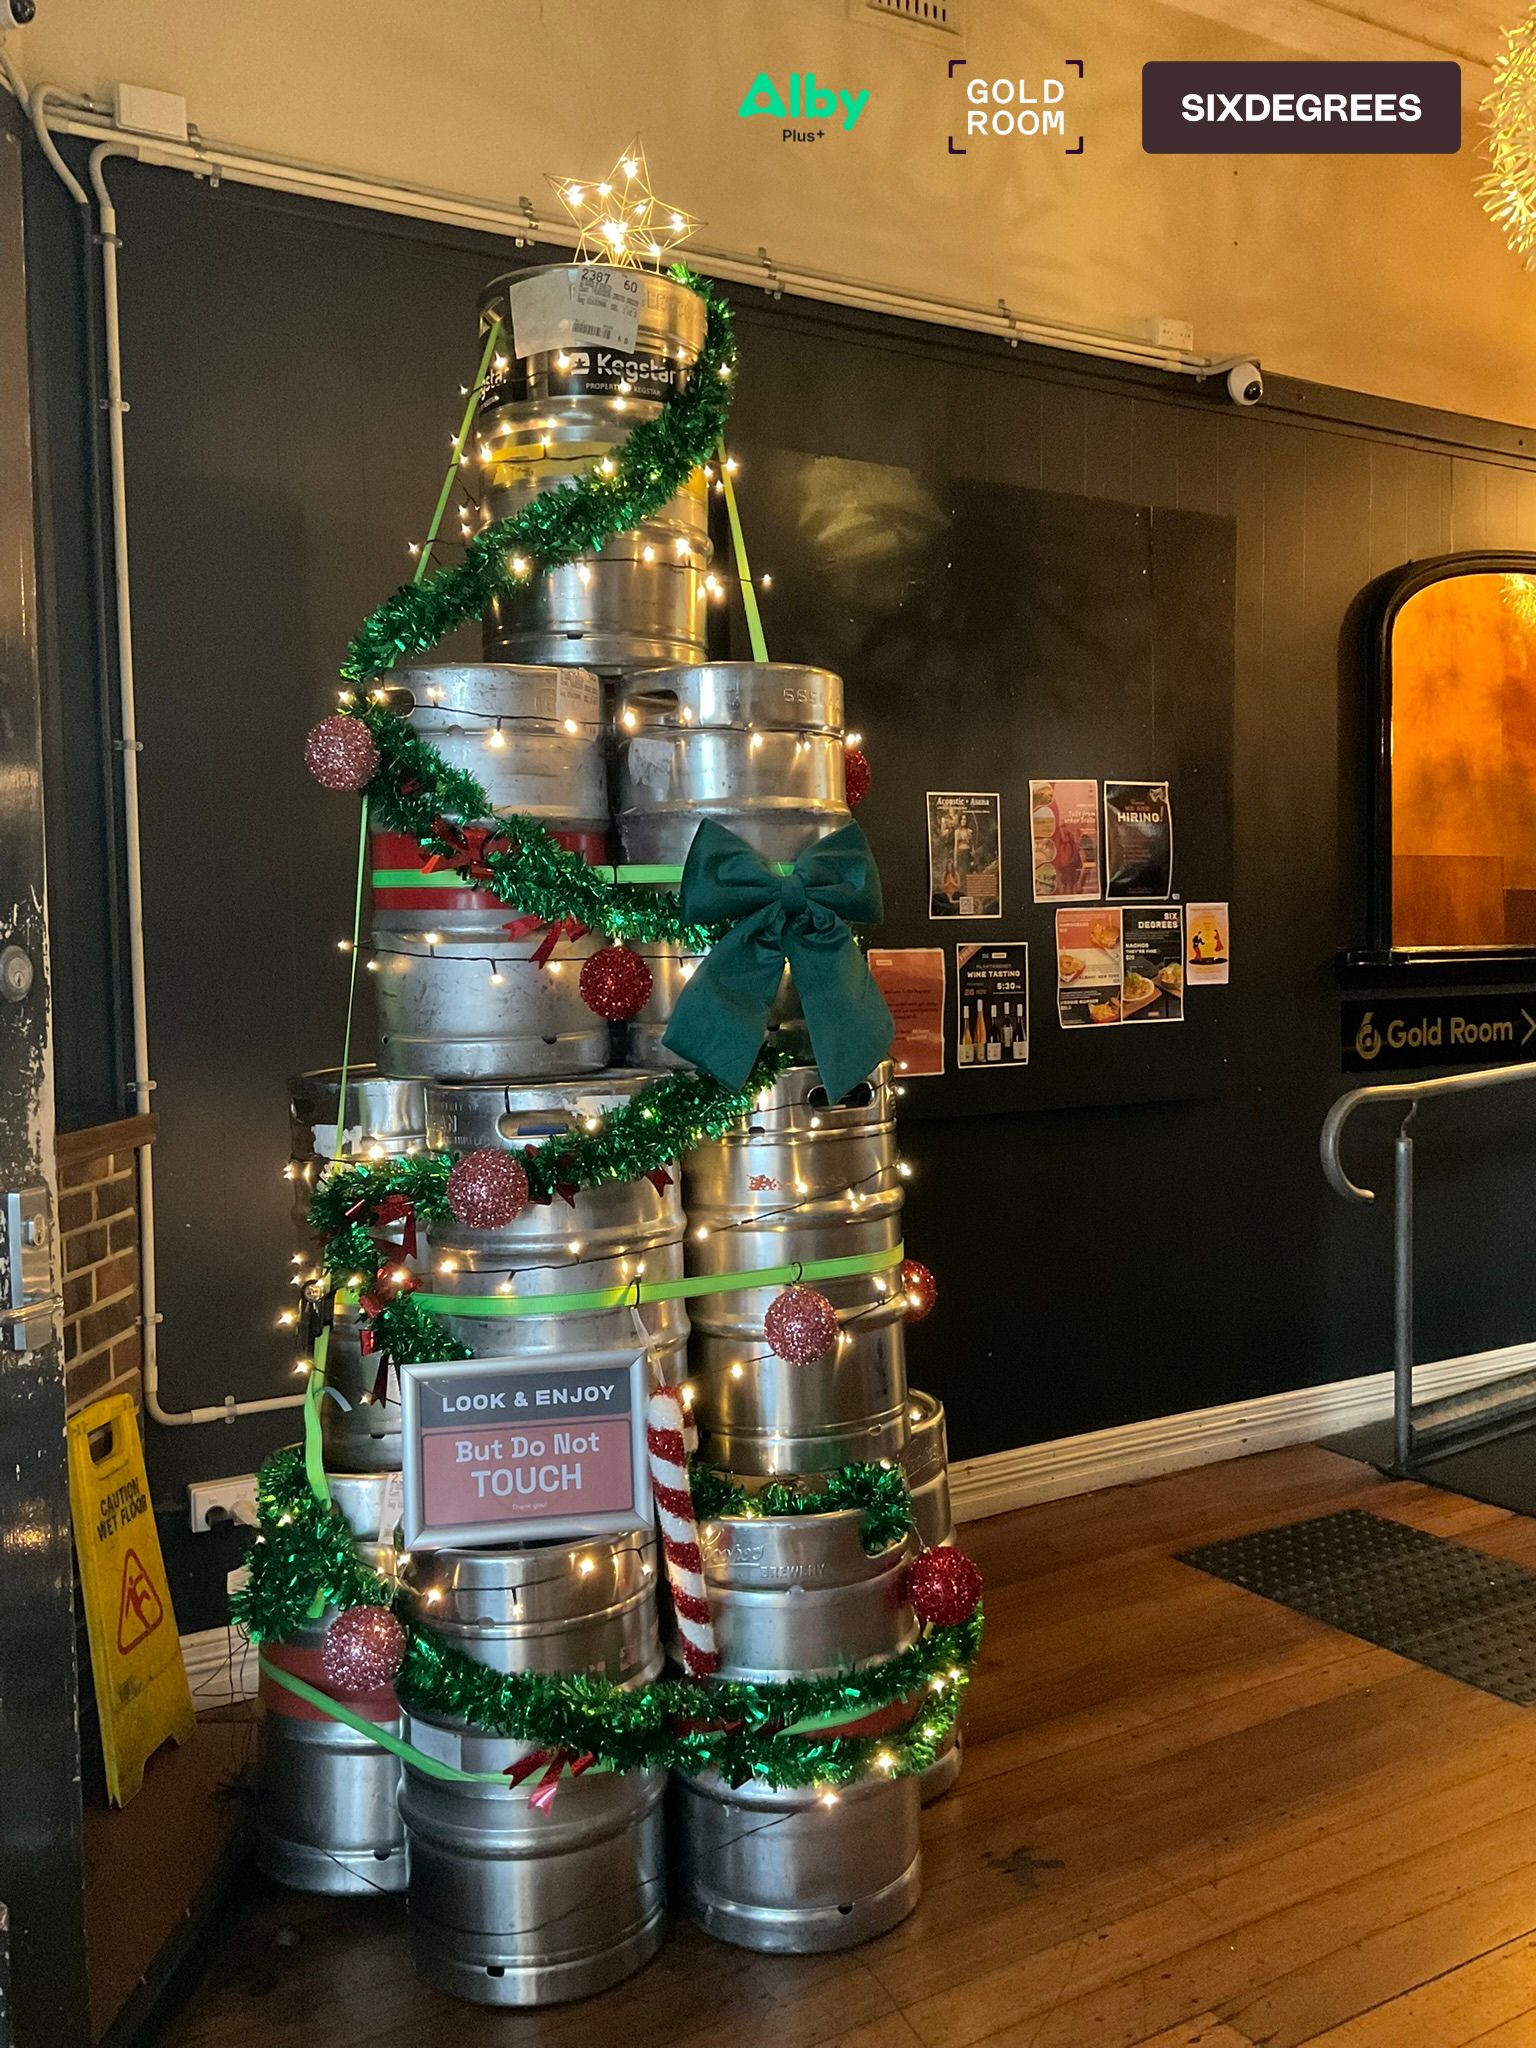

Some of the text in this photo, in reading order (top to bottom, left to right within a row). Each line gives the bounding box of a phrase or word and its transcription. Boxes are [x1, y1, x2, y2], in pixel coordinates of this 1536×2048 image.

[581, 268, 611, 285] 2387
[623, 279, 638, 294] 60
[597, 352, 677, 385] Kegstar
[633, 386, 661, 396] KEGSTAR
[936, 796, 965, 808] Acoustic
[1138, 921, 1179, 929] DEGREES
[1163, 912, 1178, 920] SIX
[988, 970, 1021, 978] TASTING
[996, 982, 1016, 990] 5:30
[1387, 1016, 1442, 1049] Gold
[1450, 1016, 1513, 1044] Room
[442, 1384, 615, 1413] LOOK & ENJOY
[455, 1431, 600, 1463] But Do Not
[470, 1462, 583, 1498] TOUCH
[100, 1477, 140, 1516] CAUTION
[97, 1494, 147, 1541] WET FLOOR
